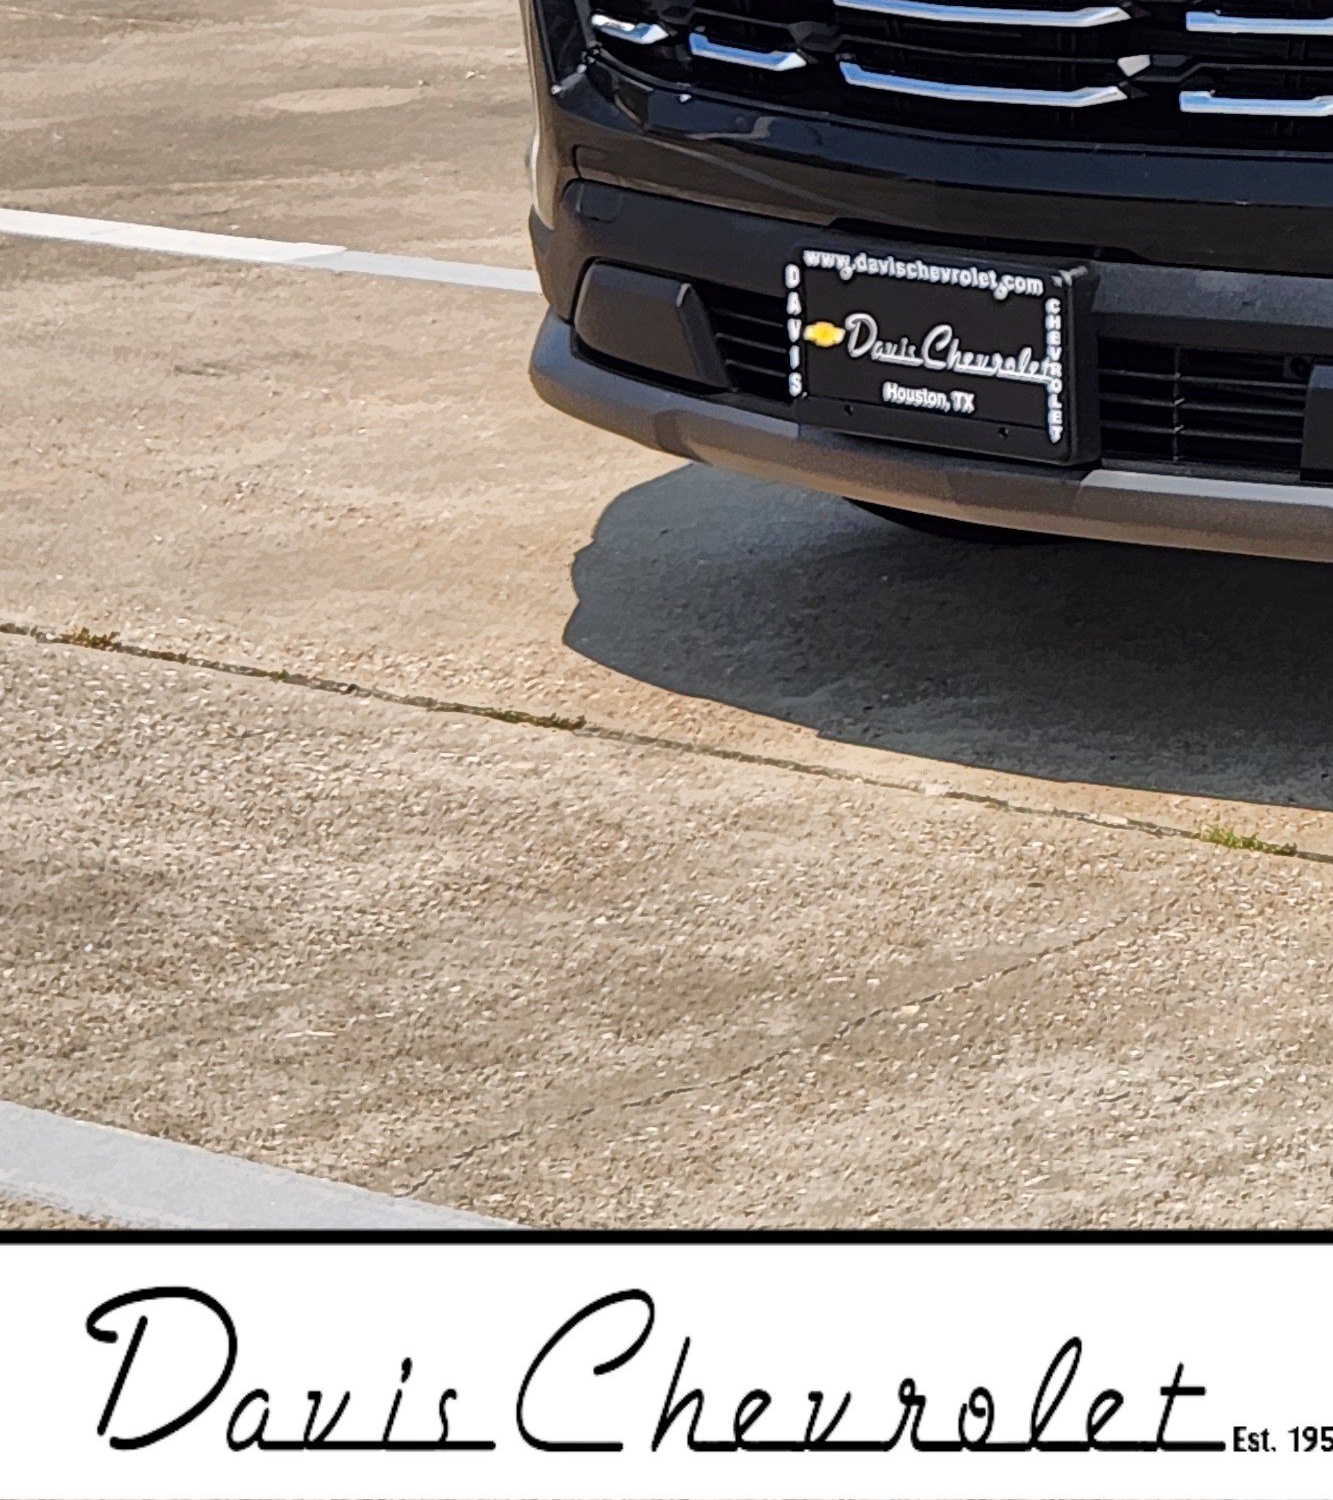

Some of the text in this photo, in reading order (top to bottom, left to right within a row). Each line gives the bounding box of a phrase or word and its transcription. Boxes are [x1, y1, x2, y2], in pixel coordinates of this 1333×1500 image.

[785, 263, 802, 396] DAVIS
[845, 312, 924, 366] Davis
[1045, 298, 1063, 444] CHEVROLET
[882, 381, 975, 414] Houston, TX
